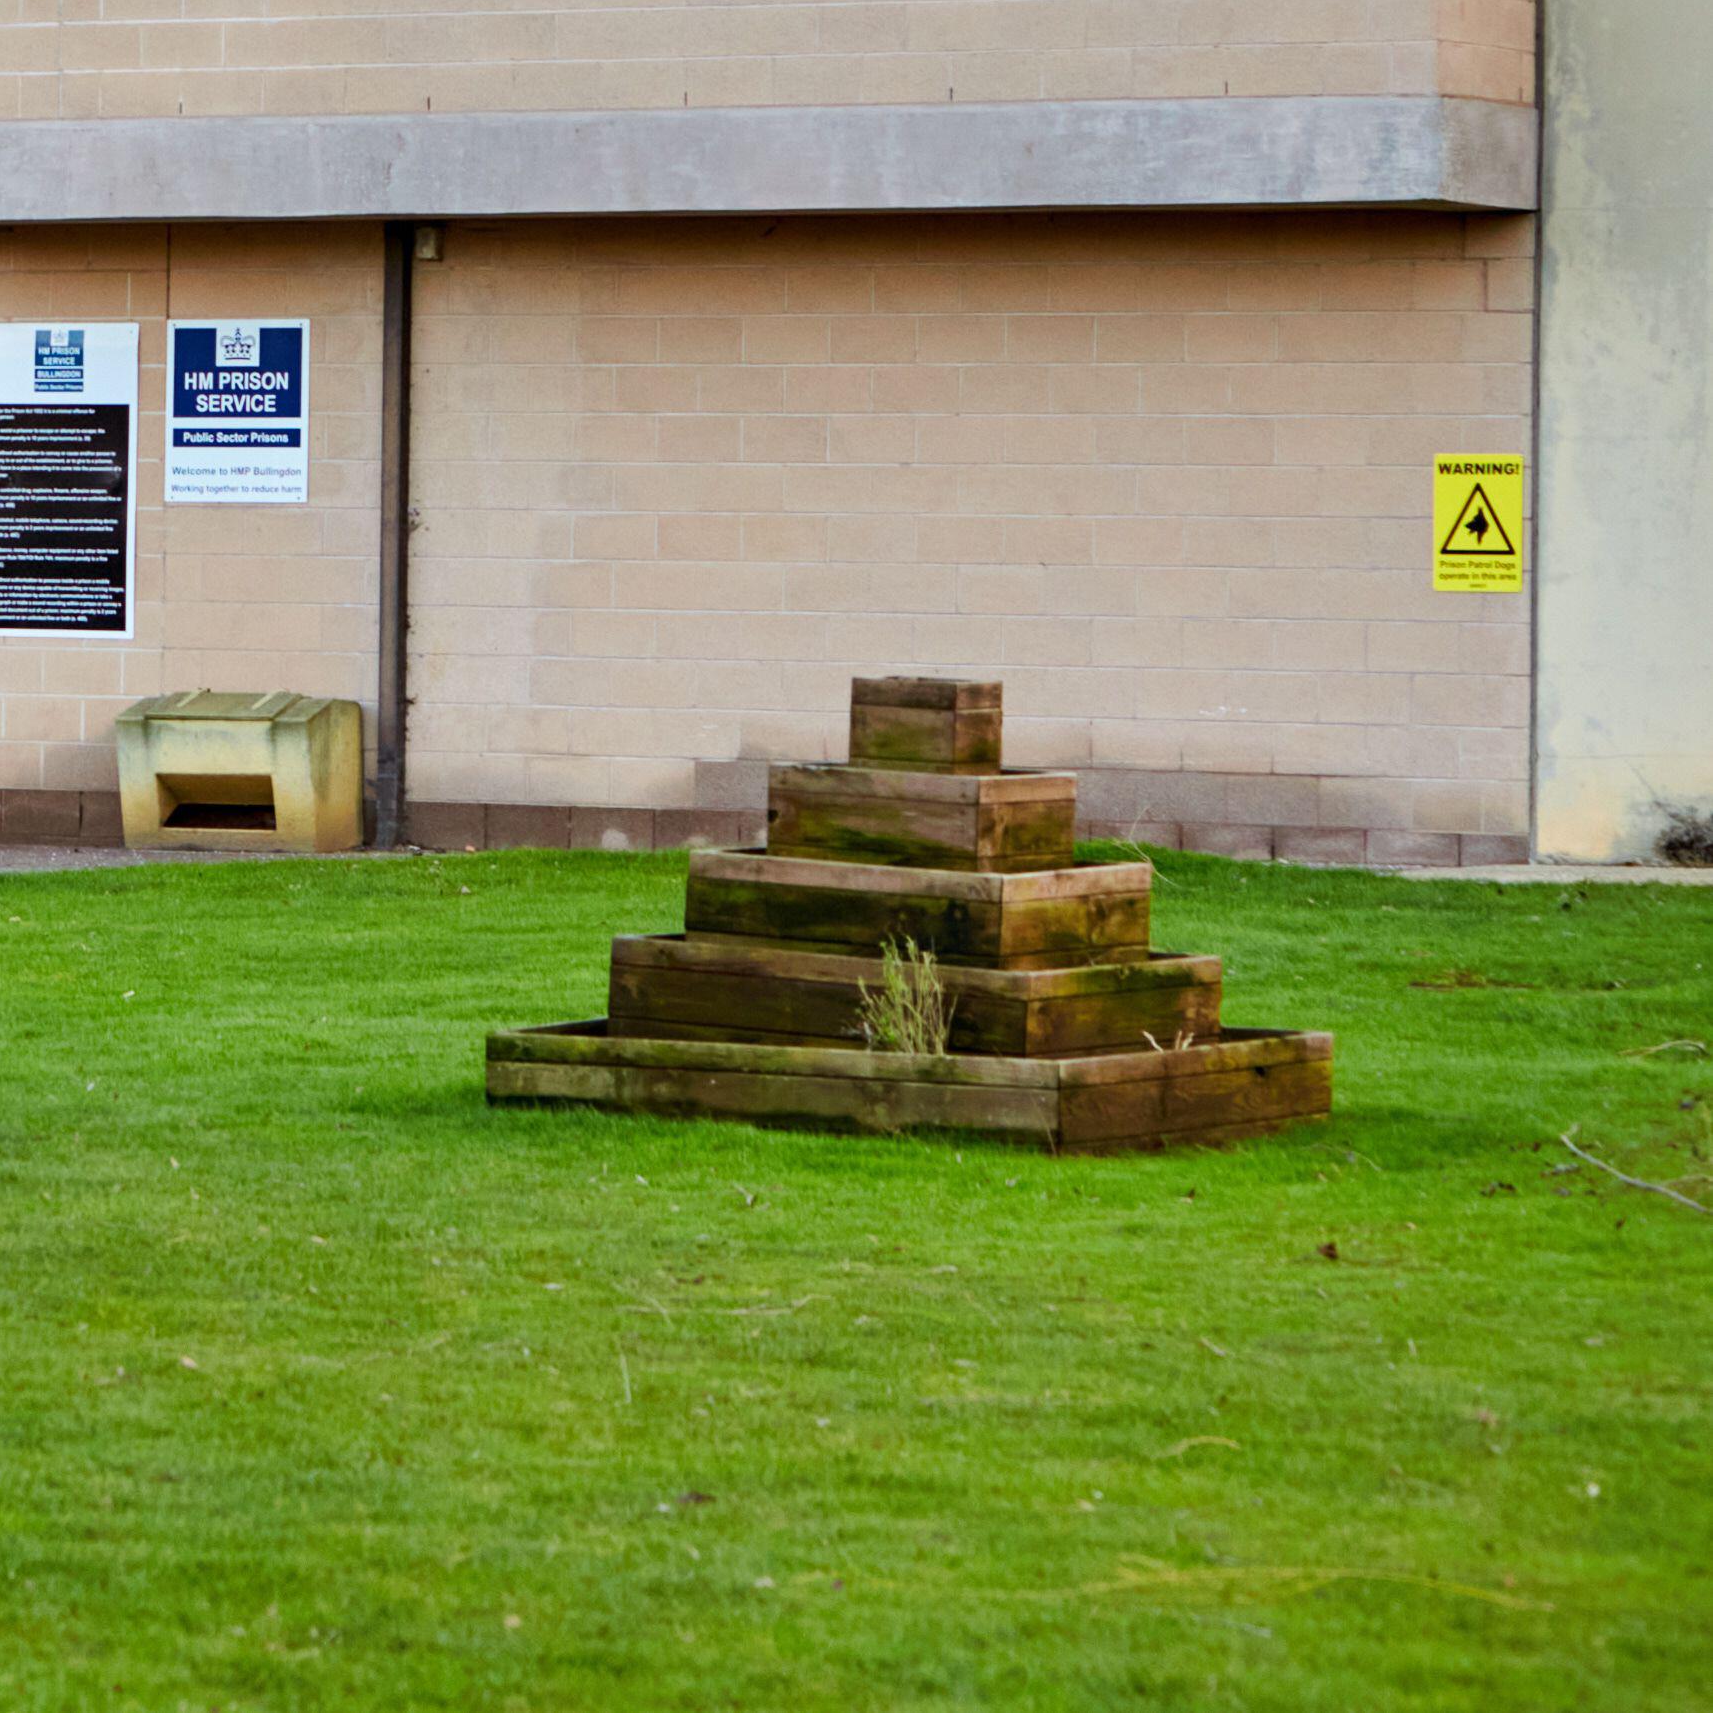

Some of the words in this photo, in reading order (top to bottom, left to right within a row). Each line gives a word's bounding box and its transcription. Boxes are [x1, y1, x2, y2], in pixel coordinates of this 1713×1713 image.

[38, 347, 50, 355] HM
[52, 347, 80, 355] PRISON
[43, 357, 75, 365] SERVICE
[184, 372, 214, 390] HM
[219, 371, 289, 390] PRISON
[195, 394, 277, 412] SERVICE
[183, 432, 214, 443] Public
[216, 432, 249, 443] Sector
[250, 432, 289, 443] Prisons
[172, 467, 216, 476] Welcome
[219, 467, 228, 476] to
[231, 467, 251, 476] HMP
[254, 467, 301, 478] Bullingdon
[1438, 463, 1519, 475] WARNING!
[171, 485, 204, 494] Working
[206, 484, 239, 494] together
[241, 485, 250, 493] to
[251, 485, 279, 493] reduce
[281, 485, 302, 493] harm
[1440, 560, 1467, 568] Prison
[1468, 560, 1493, 568] Patrol
[1494, 560, 1516, 570] Dogs
[1439, 573, 1470, 581] operate
